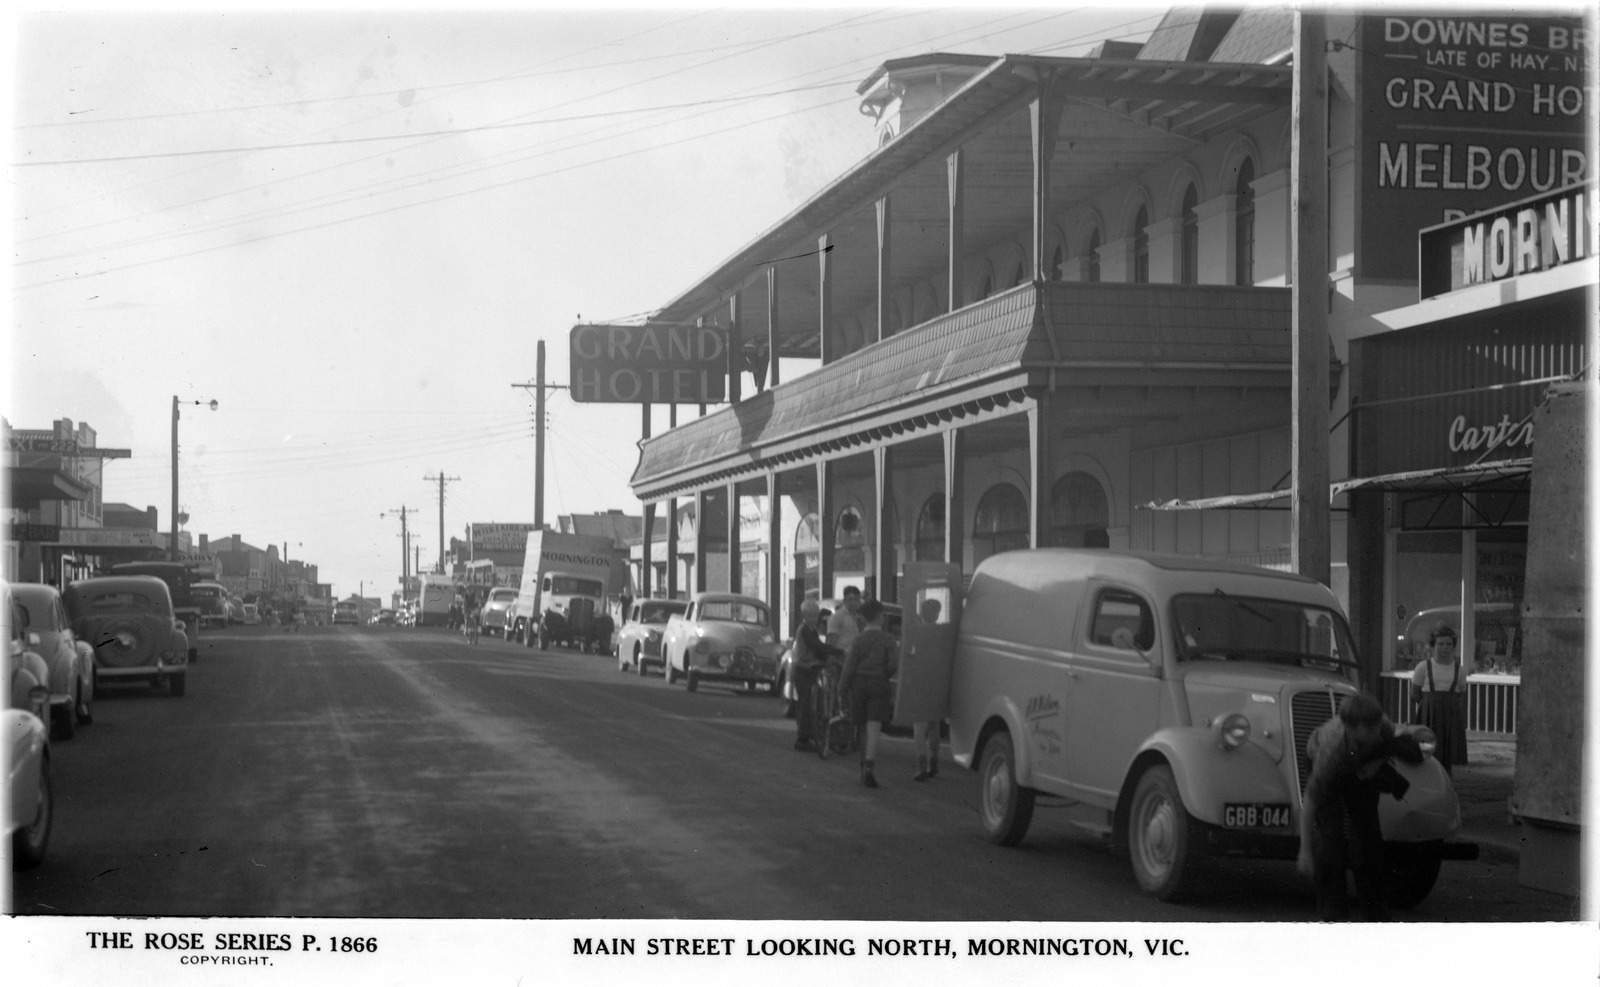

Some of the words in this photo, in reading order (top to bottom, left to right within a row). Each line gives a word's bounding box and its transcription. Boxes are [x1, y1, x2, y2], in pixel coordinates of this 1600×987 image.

[1384, 17, 1530, 47] DOWNES
[1426, 50, 1467, 67] LATE
[1477, 51, 1502, 68] OF
[1510, 53, 1549, 70] HAY
[1385, 77, 1516, 112] GRAND
[573, 327, 724, 360] GRAND
[576, 368, 722, 401] HOTEL
[542, 551, 610, 567] MORNINGTON
